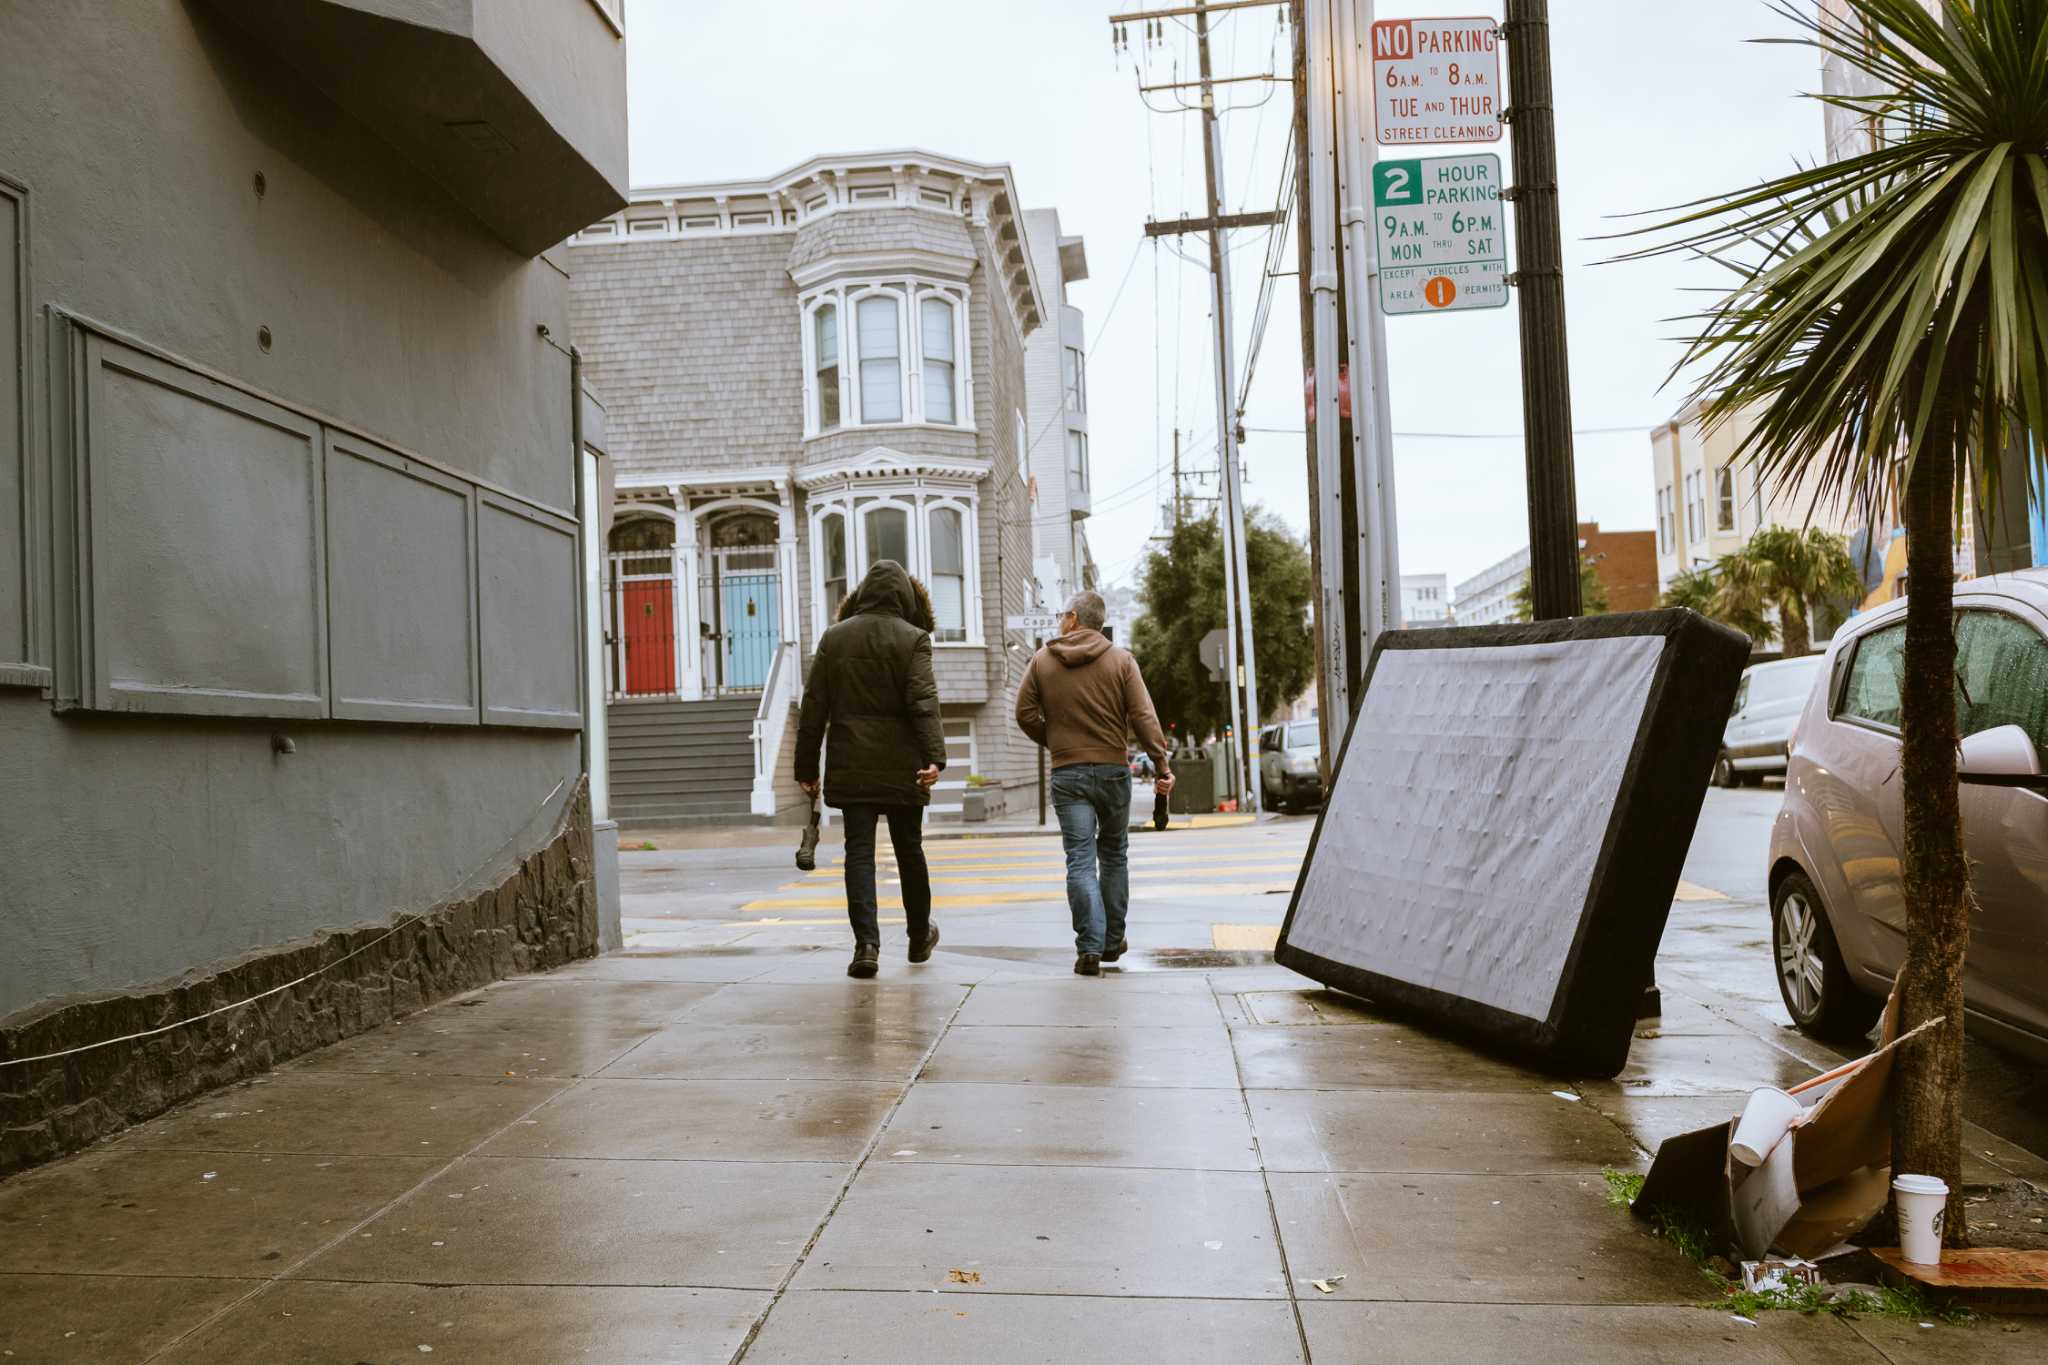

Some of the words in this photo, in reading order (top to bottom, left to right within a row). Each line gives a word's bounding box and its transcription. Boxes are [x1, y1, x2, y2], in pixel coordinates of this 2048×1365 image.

[1376, 25, 1409, 57] NO
[1418, 29, 1494, 54] PARKING
[1429, 66, 1439, 76] TO
[1390, 98, 1419, 118] TUE
[1424, 101, 1445, 113] AND
[1450, 96, 1493, 116] THUR
[1384, 127, 1429, 140] STREET
[1434, 125, 1494, 139] CLEANING
[1384, 167, 1411, 200] 2
[1438, 164, 1488, 183] HOUR
[1427, 185, 1497, 205] PARKING
[1433, 212, 1443, 221] TO
[1391, 243, 1422, 261] MON
[1432, 240, 1453, 249] THRU
[1467, 238, 1493, 255] SAT
[1384, 269, 1415, 280] EXCEPT
[1427, 265, 1470, 275] VEHICLES
[1482, 263, 1502, 272] WITH
[1390, 290, 1415, 300] AREA
[1465, 284, 1502, 295] PERMITS
